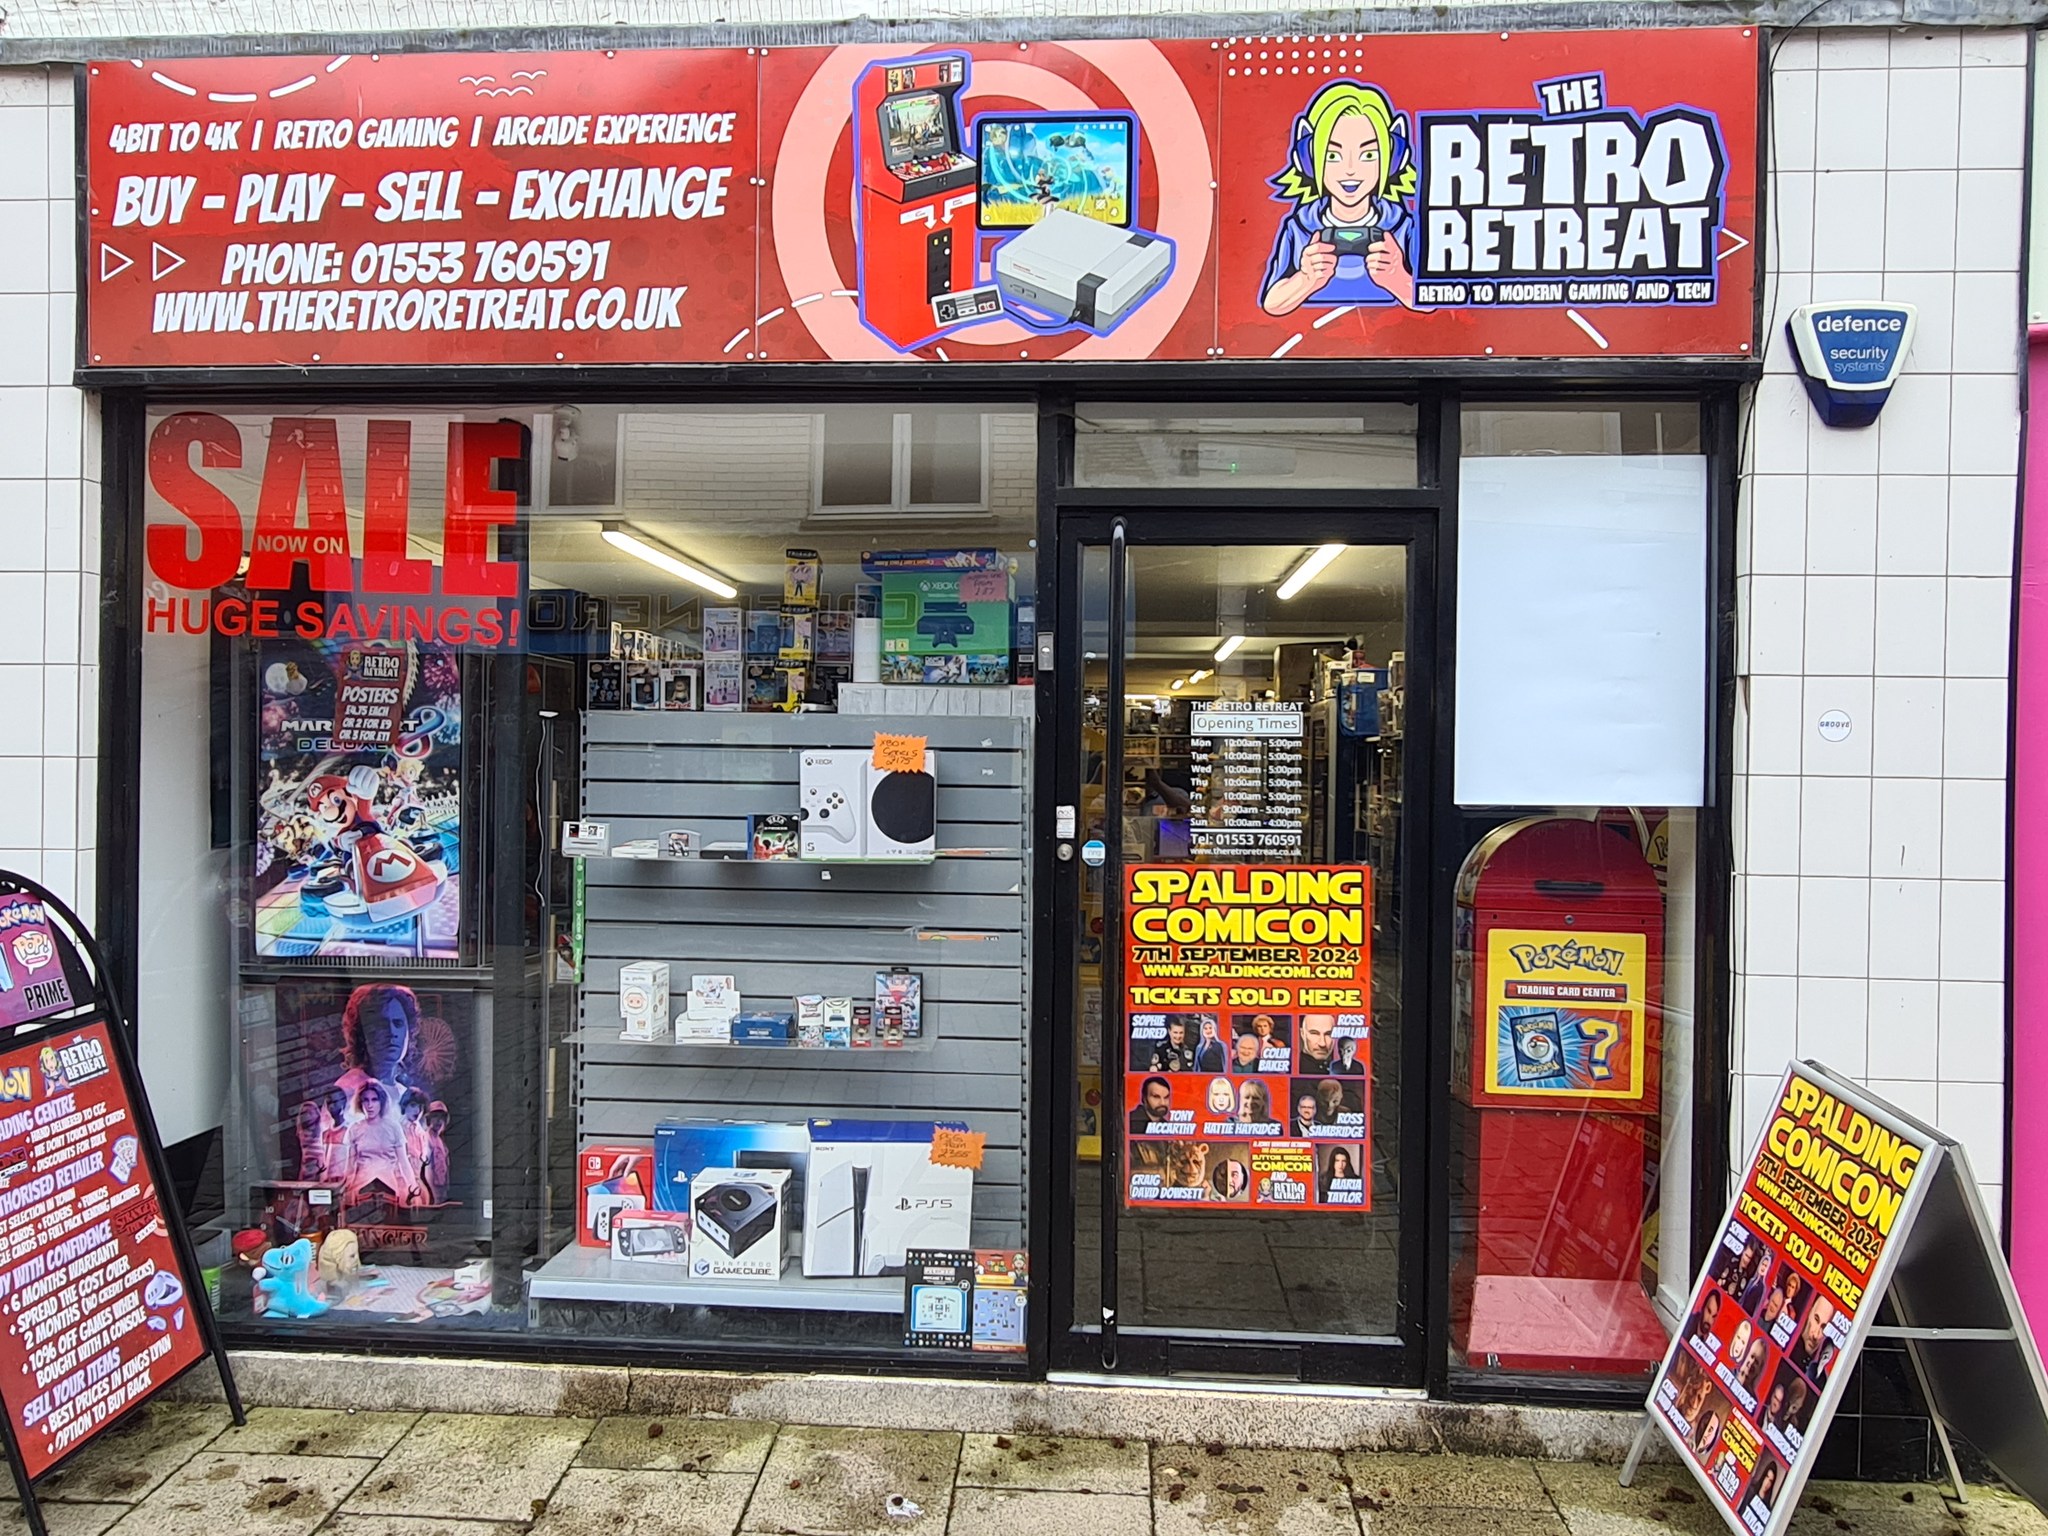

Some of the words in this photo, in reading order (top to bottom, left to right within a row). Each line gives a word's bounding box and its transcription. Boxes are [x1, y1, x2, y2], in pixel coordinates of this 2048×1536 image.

[1542, 80, 1600, 113] THE
[110, 123, 164, 151] 4BIT
[169, 123, 200, 149] TO
[205, 124, 239, 150] 4K
[274, 119, 352, 149] RETRO
[358, 117, 457, 148] GAMING
[494, 115, 587, 146] ARCADE
[596, 113, 735, 145] EXPERIENCE
[1429, 118, 1714, 206] RETRO
[112, 175, 196, 226] BUY
[234, 173, 335, 223] PLAY
[375, 171, 463, 221] SELL
[509, 167, 732, 219] EXCHANGE
[1427, 207, 1709, 272] RETREAT
[221, 243, 342, 285] PHONE:
[351, 241, 464, 284] 01553
[474, 240, 609, 282] 760591
[1419, 286, 1465, 302] RETRO
[1472, 286, 1493, 301] TO
[1500, 284, 1562, 301] MODERN
[1568, 284, 1629, 300] GAMING
[1636, 283, 1669, 299] AND
[1676, 282, 1710, 299] TECH
[152, 286, 687, 334] WWW.THERETRORETREAT.CO.UK
[1818, 316, 1901, 332] defence
[1830, 346, 1888, 362] security
[1834, 361, 1884, 374] systems
[146, 412, 521, 598] SALE
[258, 536, 307, 553] NOW
[313, 536, 343, 554] ON
[148, 597, 279, 637] HUGE
[296, 601, 518, 646] SAVINGS!
[364, 656, 399, 668] RETRO
[364, 668, 398, 677] RETREAT
[341, 686, 400, 704] POSTERS
[368, 706, 389, 716] EACH
[1191, 702, 1212, 710] THE
[1216, 702, 1252, 711] RETRO
[1255, 702, 1303, 711] RETREAT
[1197, 718, 1253, 731] Opening
[1257, 718, 1297, 728] Times
[1191, 739, 1211, 747] Mon
[1224, 739, 1261, 747] 10:00am
[1268, 739, 1301, 748] 5:00pm
[815, 758, 832, 766] XBOX
[1191, 752, 1209, 760] Tue
[1268, 753, 1301, 761] 5:00pm
[1191, 765, 1212, 773] Wed
[1268, 766, 1301, 775] 5:00pm
[1191, 778, 1208, 786] Thu
[1268, 779, 1301, 788] 5:00pm
[1224, 792, 1261, 800] 10:00am
[1268, 792, 1301, 801] 5:00pm
[1191, 805, 1205, 813] Sat
[1266, 806, 1301, 815] 5:00pm
[1268, 819, 1301, 828] 4:00pm
[808, 842, 815, 851] S
[1191, 835, 1213, 844] Tel:
[1216, 835, 1254, 845] 01553
[1258, 835, 1301, 845] 760591
[1190, 848, 1301, 856] www.theretroretreat.co.uk
[1132, 870, 1362, 905] SPALDING
[1132, 908, 1362, 944] COMICON
[12, 933, 48, 960] POP!
[1133, 947, 1172, 962] 7TH
[1180, 947, 1300, 963] SEPTEMBER
[1309, 948, 1359, 964] 2024
[1143, 964, 1353, 979] WWW.SPALDINGCOMI.COM
[24, 978, 68, 1011] PRIME
[1130, 988, 1221, 1004] TICKETS
[1229, 988, 1291, 1006] SOLD
[1299, 990, 1361, 1006] HERE
[1517, 985, 1554, 995] TRADING
[1557, 987, 1580, 996] CARD
[1583, 987, 1615, 997] CENTER
[1132, 1015, 1166, 1026] SOPHIE
[1338, 1014, 1364, 1025] ROSS
[1131, 1028, 1167, 1039] ALDRED
[59, 1039, 102, 1065] RETRO
[1263, 1049, 1290, 1059] COLIN
[66, 1056, 107, 1079] RETREAT
[1258, 1060, 1290, 1071] BAKER
[34, 1093, 76, 1125] CENTRE
[1170, 1110, 1194, 1121] TONY
[1337, 1113, 1364, 1124] ROSS
[1146, 1123, 1197, 1134] MCCARTHY
[1204, 1123, 1234, 1134] HATTIE
[1235, 1123, 1281, 1135] HAYRIDGE
[1309, 1126, 1364, 1138] SAMBRIDGE
[1781, 1076, 1921, 1188] SPALDING
[55, 1151, 104, 1190] RETAILER
[1252, 1161, 1312, 1172] COMICON
[1132, 1174, 1160, 1185] CRAIG
[1768, 1117, 1903, 1236] COMICON
[916, 1199, 952, 1208] PS5
[1327, 1192, 1362, 1203] TAYLOR
[1757, 1153, 1781, 1178] 7TH
[1781, 1169, 1848, 1232] SEPTEMBER
[1847, 1222, 1883, 1258] 2024
[1756, 1174, 1870, 1273] WWW.SPALDINGCOMI.COM
[14, 1254, 45, 1289] WITH
[46, 1219, 113, 1270] CONFIDENCE
[1739, 1192, 1788, 1242] TICKETS
[1785, 1232, 1824, 1274] SOLD
[1823, 1262, 1861, 1310] HERE
[11, 1298, 20, 1312] 6
[22, 1273, 67, 1304] MONTHS
[69, 1239, 119, 1282] WARRANTY
[713, 1267, 772, 1275] GAMECUBE
[17, 1297, 58, 1334] SPREAD
[58, 1287, 79, 1309] THE
[78, 1271, 105, 1298] COST
[106, 1255, 131, 1283] OVER
[28, 1345, 54, 1372] 10%
[57, 1331, 78, 1353] OFF
[79, 1310, 113, 1344] GAMES
[36, 1354, 77, 1388] BOUGHT
[78, 1340, 103, 1366] WITH
[102, 1337, 110, 1349] A
[111, 1305, 147, 1343] CONSOLE
[23, 1395, 52, 1427] SELL
[53, 1371, 86, 1408] YOUR
[86, 1347, 121, 1383] ITEMS
[55, 1415, 91, 1451] OPTION
[91, 1408, 107, 1424] TO
[107, 1389, 126, 1412] BUY
[127, 1369, 152, 1397] BACK
